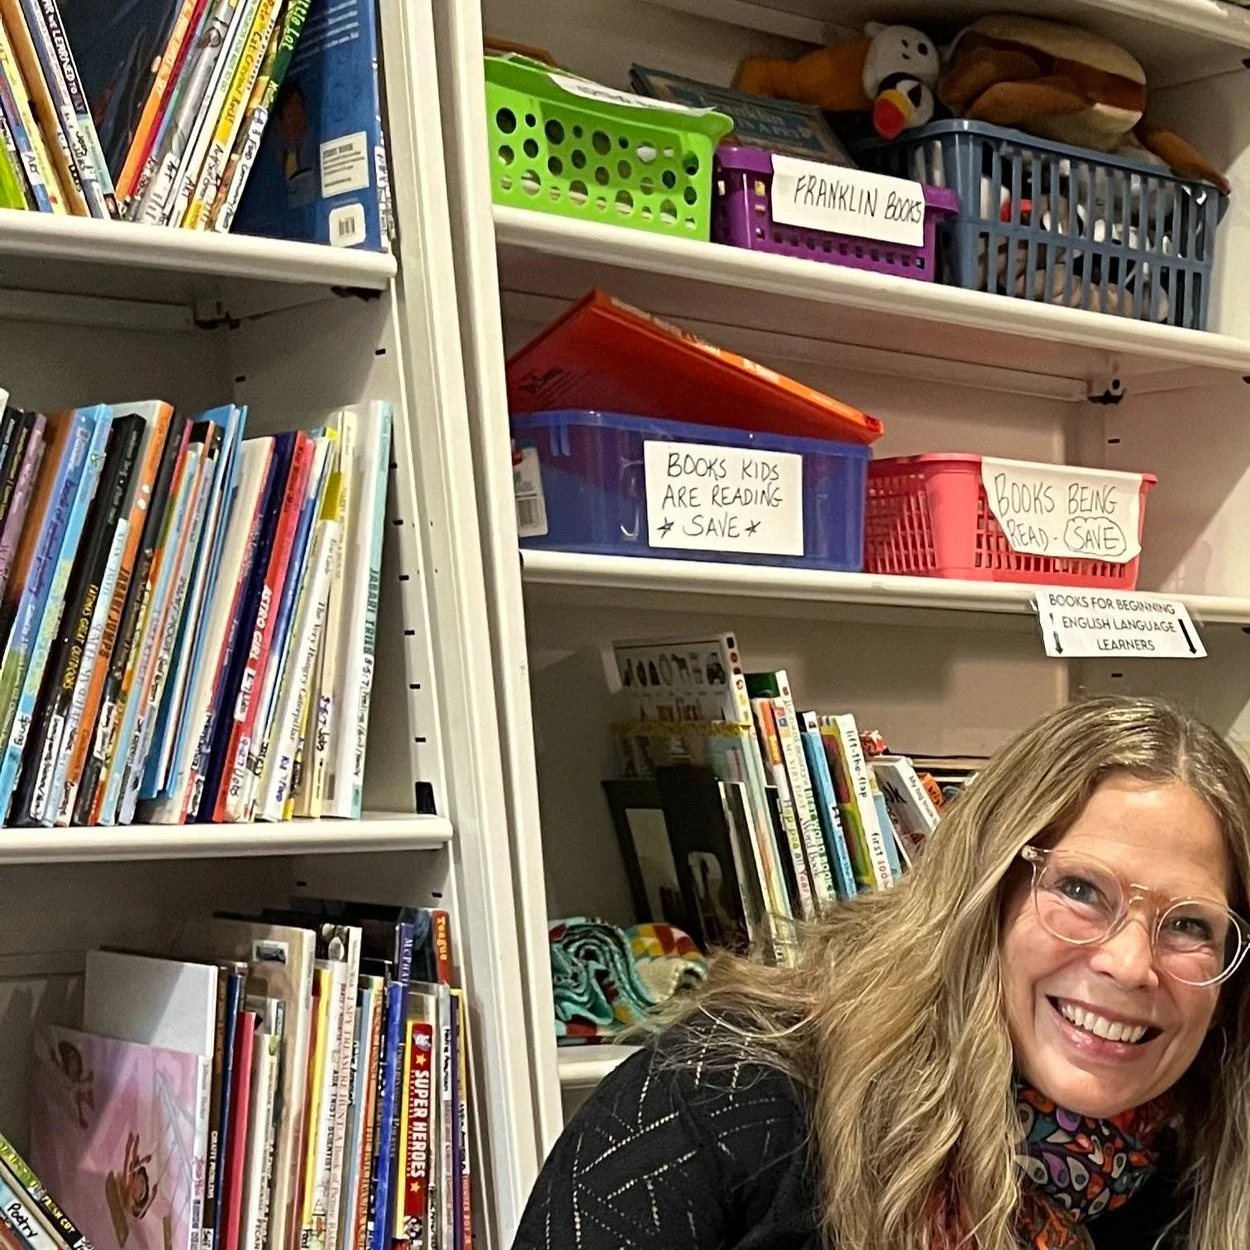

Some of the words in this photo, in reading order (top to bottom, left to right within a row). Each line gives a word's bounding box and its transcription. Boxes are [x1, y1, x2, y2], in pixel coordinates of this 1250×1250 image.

[51, 28, 76, 81] LEARNED
[247, 30, 263, 52] Cat
[281, 27, 300, 51] Lot
[224, 96, 241, 123] Rock!
[794, 174, 878, 218] FRANKLIN
[884, 191, 922, 224] BOOKS
[667, 452, 726, 478] BOOKS
[742, 460, 779, 481] KIDS
[662, 484, 701, 509] ARE
[711, 481, 782, 507] READING
[994, 473, 1055, 517] BOOKS
[1067, 482, 1117, 514] BEING
[683, 512, 740, 538] SAVE
[1006, 518, 1049, 551] READ
[1073, 525, 1120, 550] SAVE
[111, 568, 132, 615] JABARI
[256, 584, 272, 629] ASTRO
[368, 568, 380, 615] JABARI
[1049, 594, 1089, 609] BOOKS
[1091, 597, 1113, 610] FOR
[1116, 599, 1175, 615] BEGINNING
[315, 600, 326, 619] The
[1062, 616, 1111, 630] ENGLISH
[1113, 618, 1176, 632] LANGUAGE
[73, 616, 90, 643] GREAT
[99, 616, 120, 659] JUMPS
[249, 630, 263, 660] GIRL
[308, 622, 322, 644] Very
[1097, 639, 1155, 651] LEARNERS
[59, 644, 84, 689] OUTDOORS
[299, 647, 316, 685] Hungry
[11, 714, 31, 746] Spring
[287, 687, 306, 743] Caterpillar
[845, 729, 869, 798] lift-the-flap
[229, 767, 244, 797] Jobs
[921, 800, 936, 818] truck
[800, 818, 817, 849] Word
[810, 818, 826, 853] WORD
[794, 851, 806, 866] all
[808, 851, 822, 879] Book
[870, 831, 883, 855] first
[877, 859, 888, 879] 100
[797, 869, 811, 893] Year
[436, 916, 447, 960] Teague
[344, 1005, 354, 1023] SPY
[339, 1029, 352, 1087] TREASURE
[411, 1069, 429, 1117] SUPER
[324, 1125, 334, 1172] SCIENTIST
[334, 1145, 342, 1168] Book
[409, 1120, 428, 1177] HEROES
[206, 1161, 215, 1199] PROBLEMS
[328, 1176, 339, 1216] Picture
[461, 1176, 469, 1211] THUNDER
[5, 1200, 41, 1240] Poetry
[58, 1216, 75, 1235] CUT
[253, 1218, 264, 1249] PECAN
